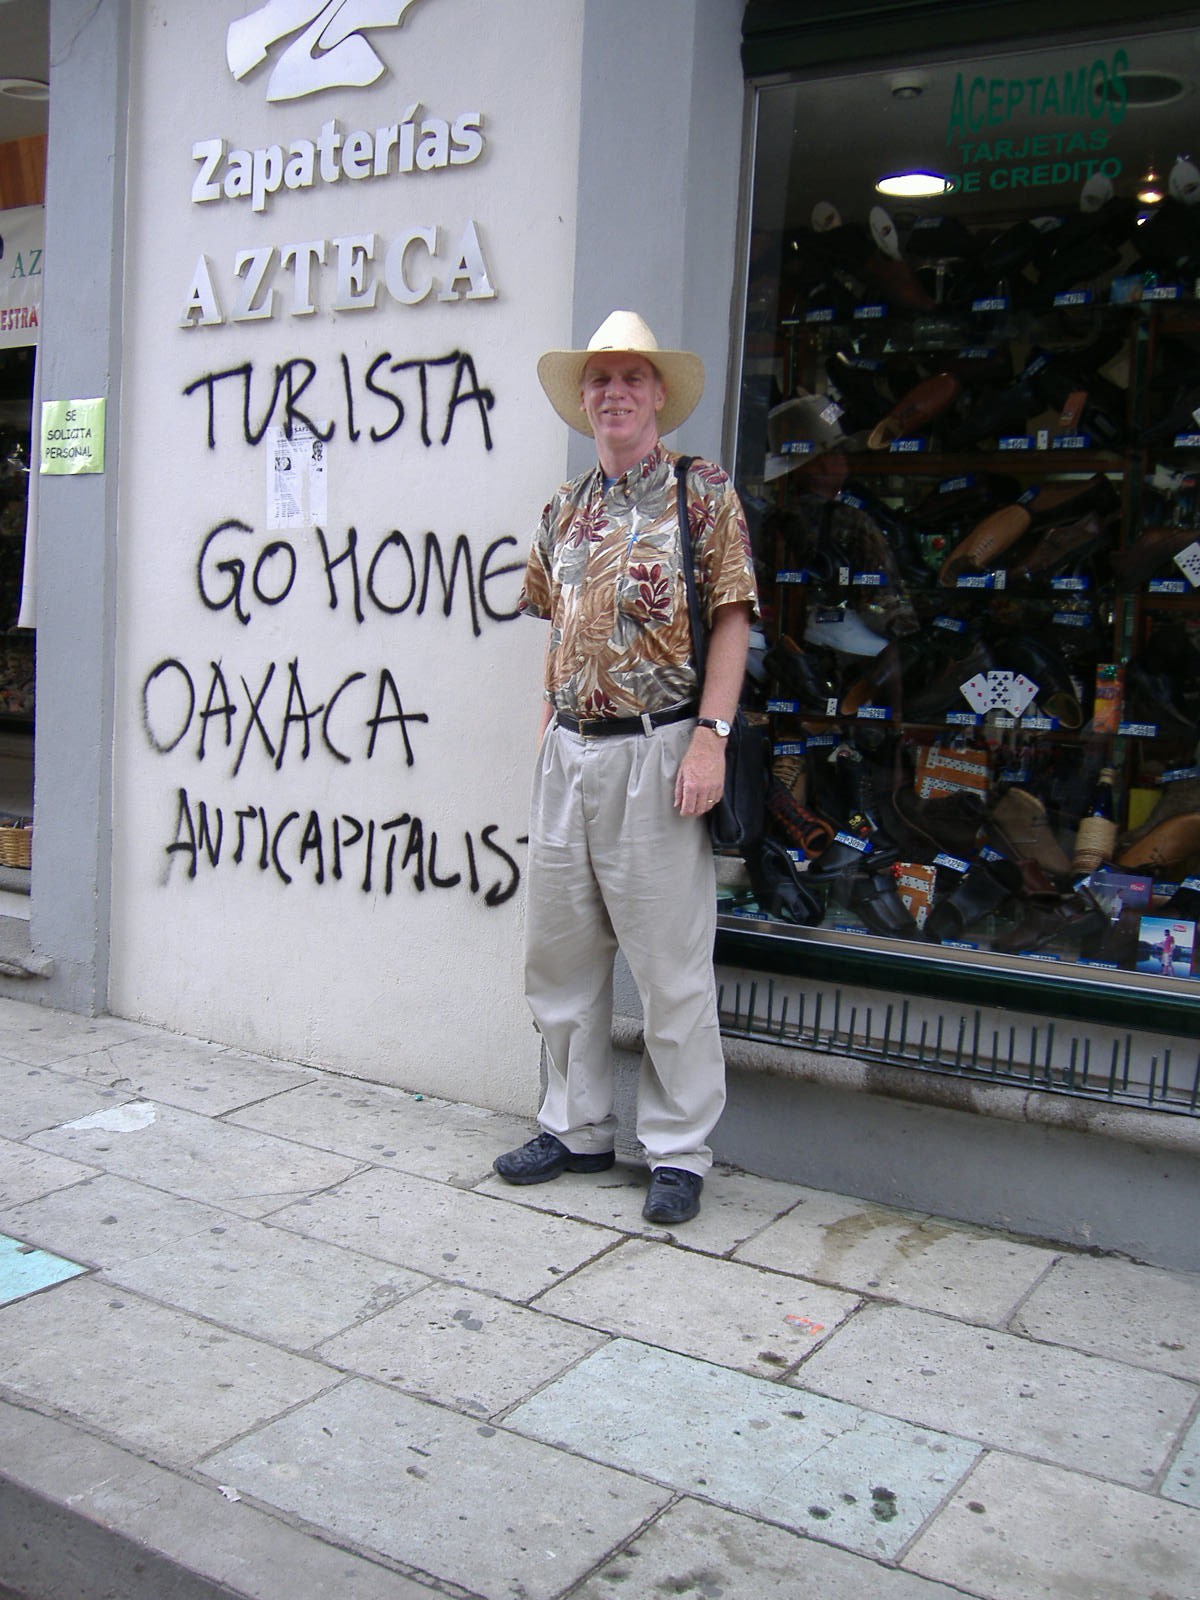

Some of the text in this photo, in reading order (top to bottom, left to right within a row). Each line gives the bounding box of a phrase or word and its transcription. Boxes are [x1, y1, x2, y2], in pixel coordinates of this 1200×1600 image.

[947, 48, 1128, 146] ACEPTAMOS
[192, 103, 484, 212] Zapaterías
[943, 156, 1123, 195] DE CREDITO
[958, 128, 1110, 165] TARJETAS
[179, 219, 498, 328] AZTECA
[0, 305, 39, 331] ESTRA
[47, 428, 92, 440] SOLICITA
[65, 409, 77, 421] SE
[182, 350, 496, 451] TURISTA
[46, 446, 92, 459] PERSONAL
[197, 518, 529, 638] GO HOME
[142, 656, 429, 778] OAXACA
